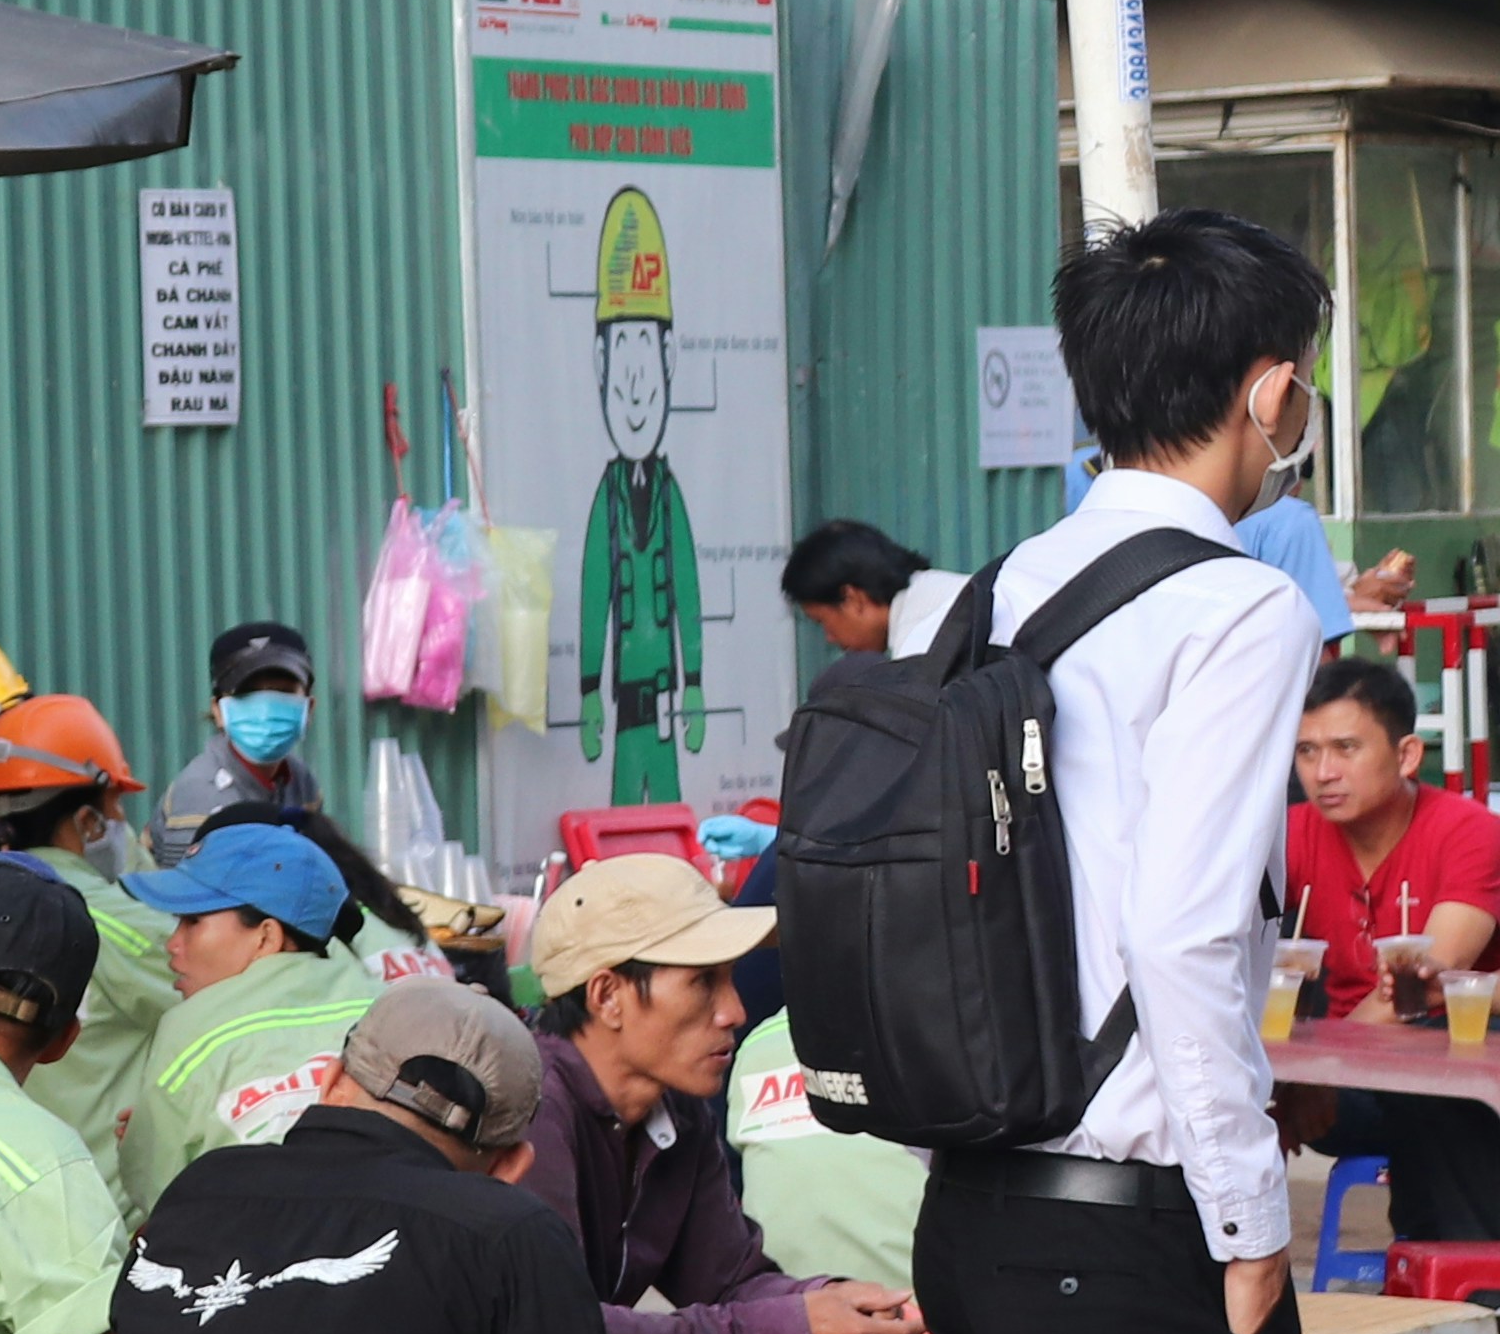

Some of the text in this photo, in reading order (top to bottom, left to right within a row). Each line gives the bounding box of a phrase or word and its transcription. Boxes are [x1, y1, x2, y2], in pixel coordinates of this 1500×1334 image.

[631, 253, 662, 290] AP
[163, 315, 199, 330] CAM
[152, 342, 207, 357] CHANH
[171, 396, 204, 412] RAU
